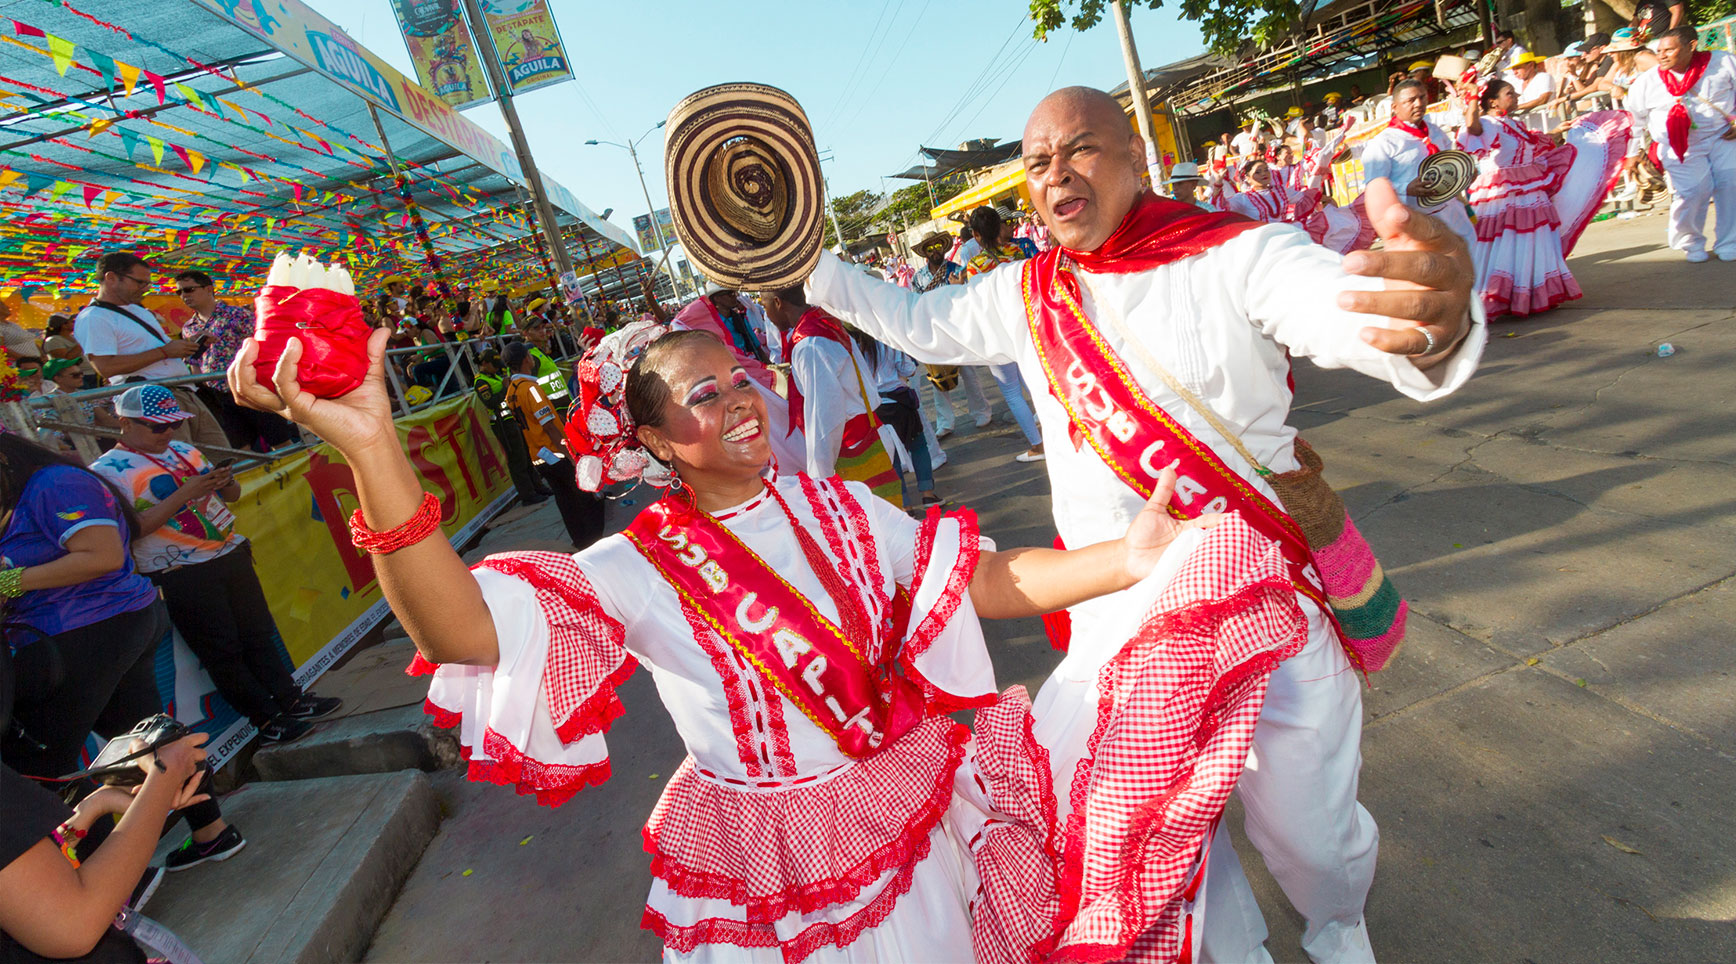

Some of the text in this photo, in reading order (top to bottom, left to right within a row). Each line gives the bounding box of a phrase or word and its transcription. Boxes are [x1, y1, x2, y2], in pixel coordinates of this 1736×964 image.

[314, 35, 396, 109] AGUILA
[513, 58, 560, 81] AGUILA
[207, 753, 222, 767] EL
